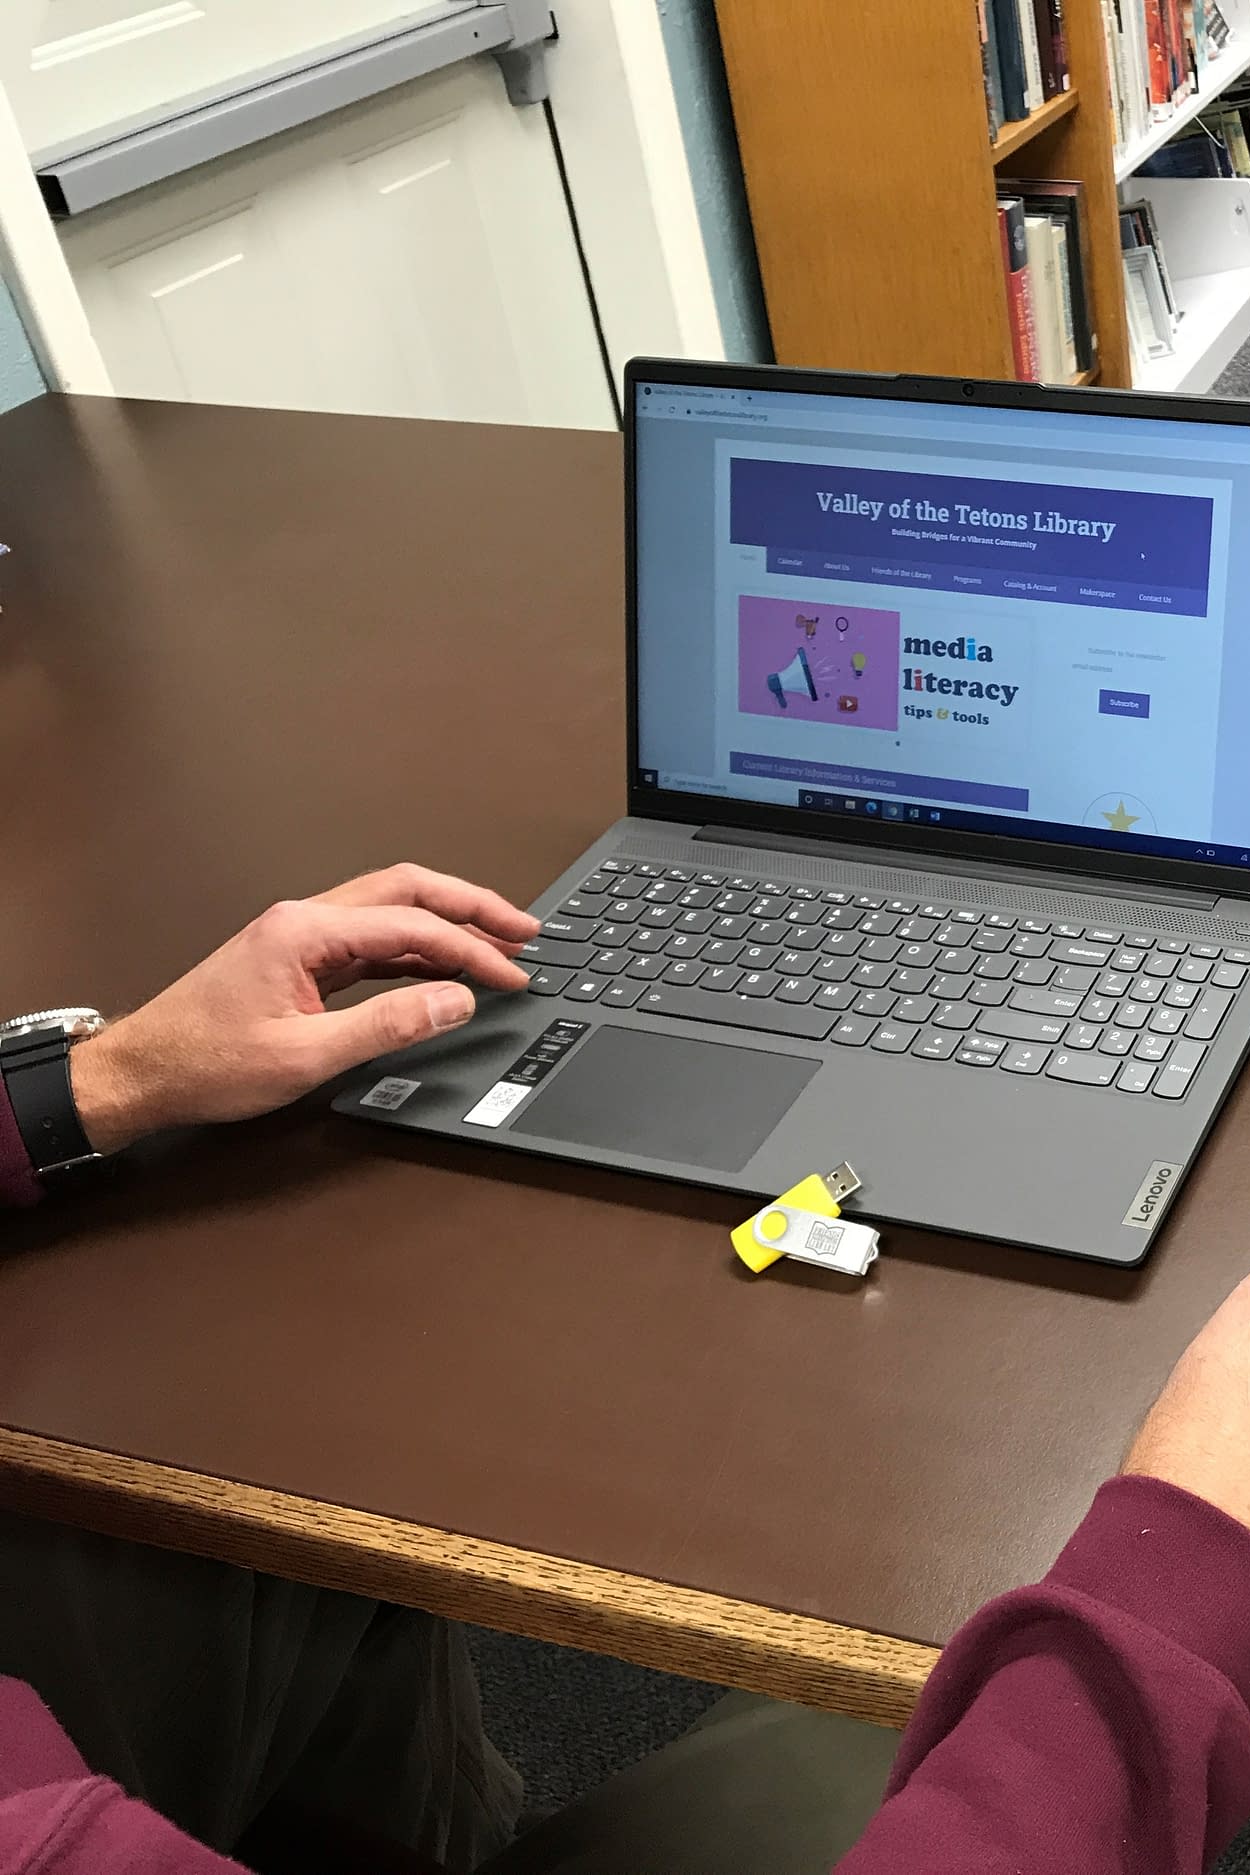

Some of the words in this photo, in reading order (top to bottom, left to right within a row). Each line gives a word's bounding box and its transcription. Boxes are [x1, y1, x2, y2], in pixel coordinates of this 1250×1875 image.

[817, 492, 883, 521] Valley
[889, 498, 911, 519] of
[915, 501, 950, 523] the
[955, 504, 1028, 530] Tetons
[1033, 511, 1117, 543] Library
[892, 529, 921, 539] Building
[922, 531, 948, 542] Bridges
[949, 533, 960, 542] for
[967, 535, 994, 545] Vibrant
[995, 538, 1037, 551] Community
[777, 557, 803, 566] Calendar
[824, 562, 841, 571] About
[872, 567, 892, 576] Friends
[911, 571, 932, 581] Library
[953, 575, 982, 585] Programs
[1003, 580, 1026, 590] Catalog
[1033, 583, 1057, 593] Account
[1080, 588, 1117, 599] Makerspace
[1139, 594, 1161, 603] Contact
[903, 637, 993, 662] media
[903, 668, 1019, 707] literacy
[1109, 699, 1139, 709] Subscribe
[904, 705, 933, 720] tips
[936, 708, 949, 720] &
[952, 711, 990, 725] tools
[743, 760, 773, 773] Current
[775, 763, 803, 777] Library
[803, 766, 854, 782] Information
[855, 774, 861, 783] &
[862, 776, 897, 787] Services
[1055, 999, 1075, 1008] Enter
[1169, 1065, 1191, 1074] Enter
[1132, 1168, 1172, 1222] Lenovo
